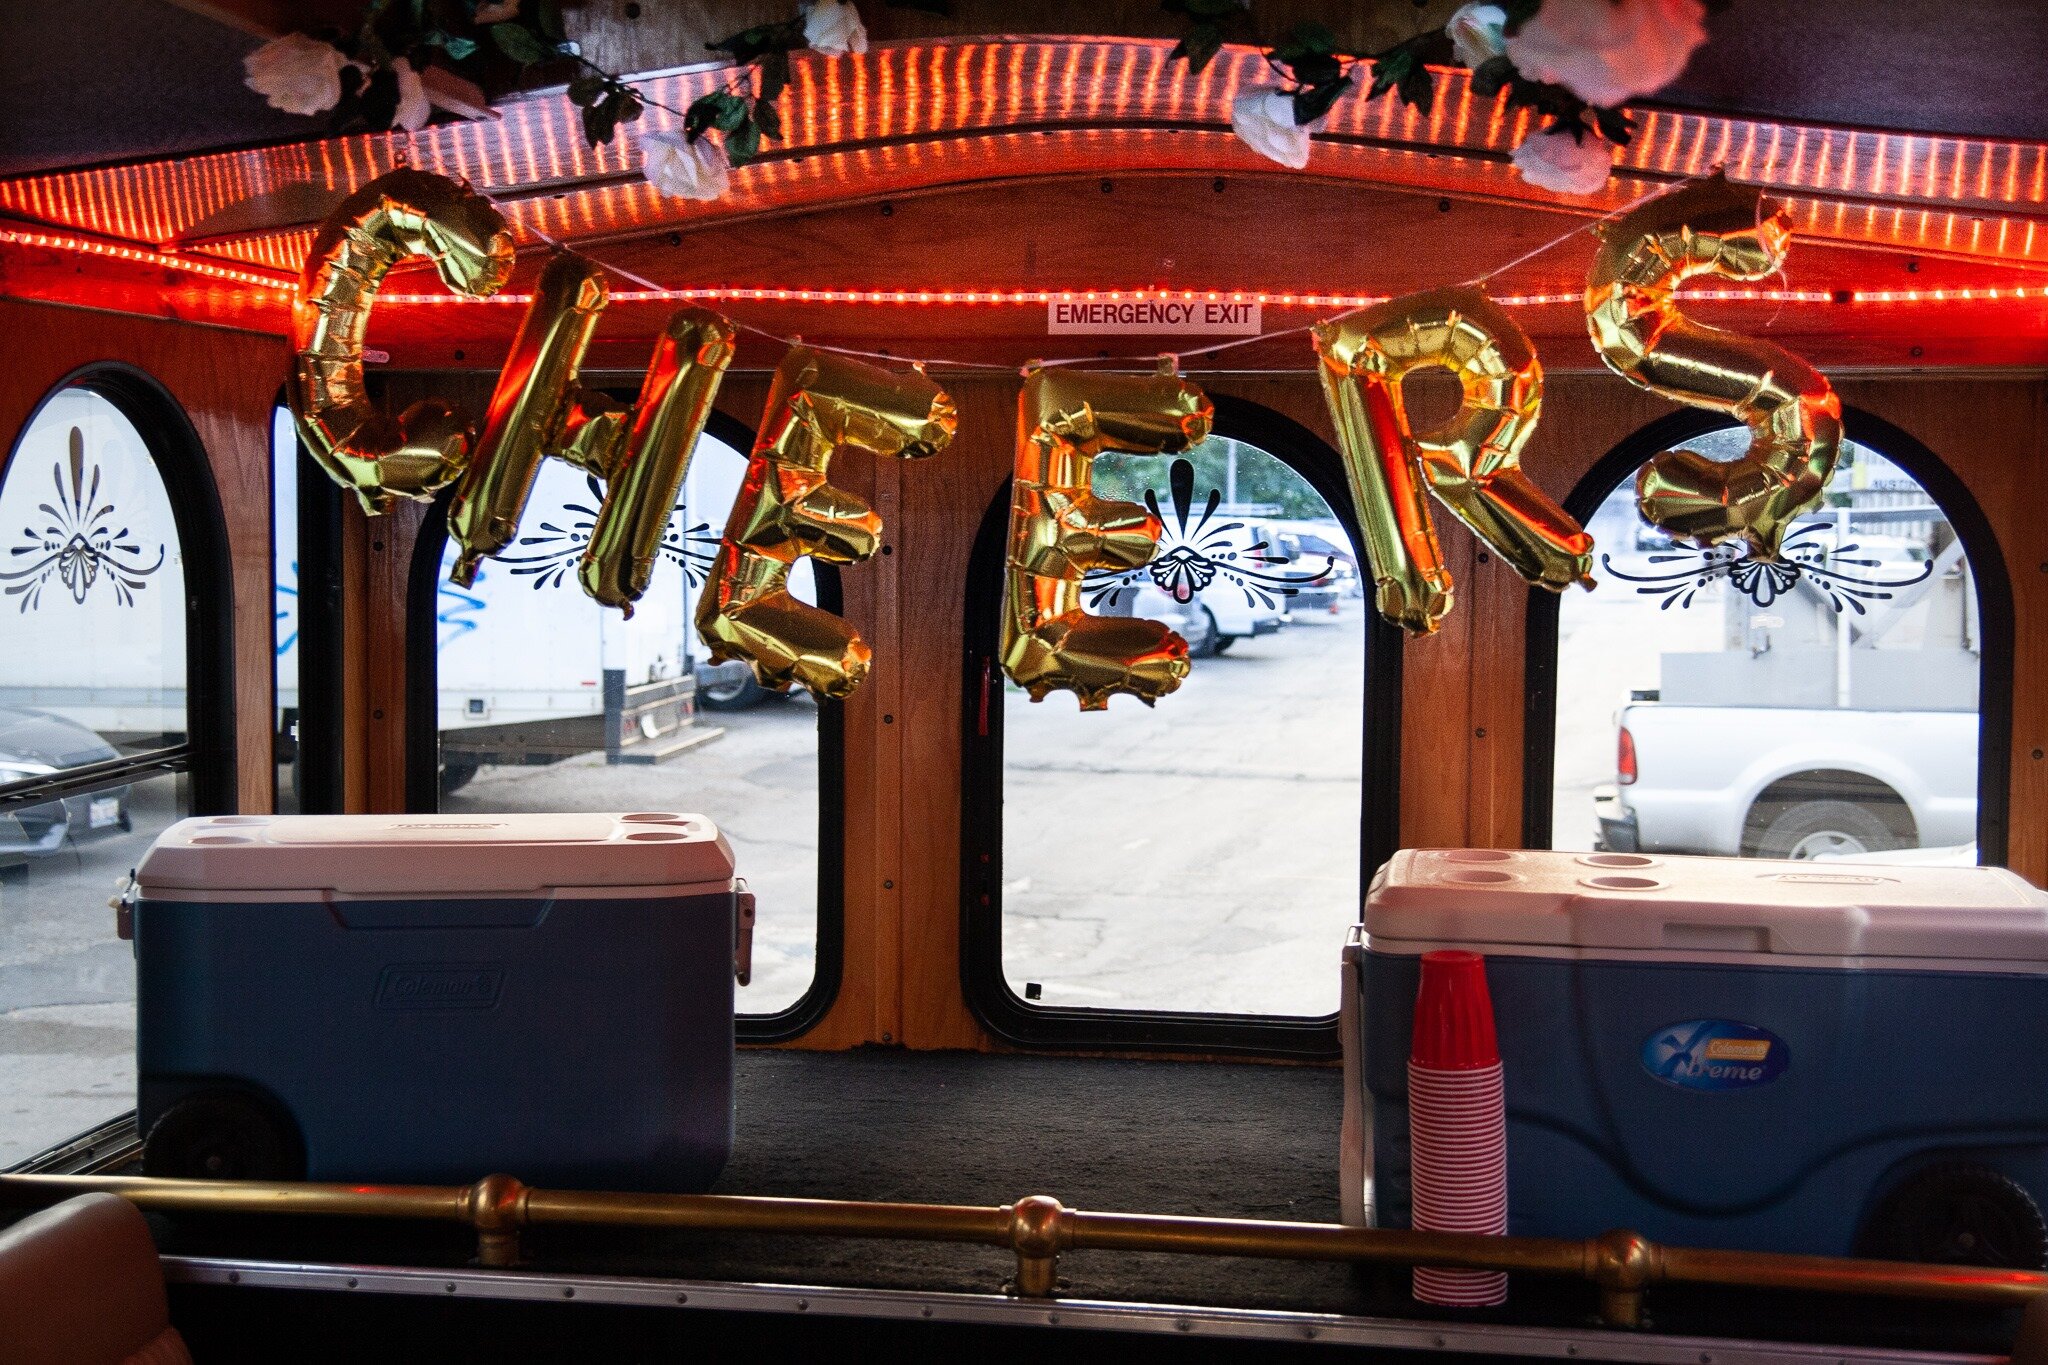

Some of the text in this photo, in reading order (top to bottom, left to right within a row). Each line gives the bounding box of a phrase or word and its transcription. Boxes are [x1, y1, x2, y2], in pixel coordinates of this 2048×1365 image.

[291, 166, 1844, 712] CHEERS
[1056, 303, 1253, 324] EMERGENCY EXIT
